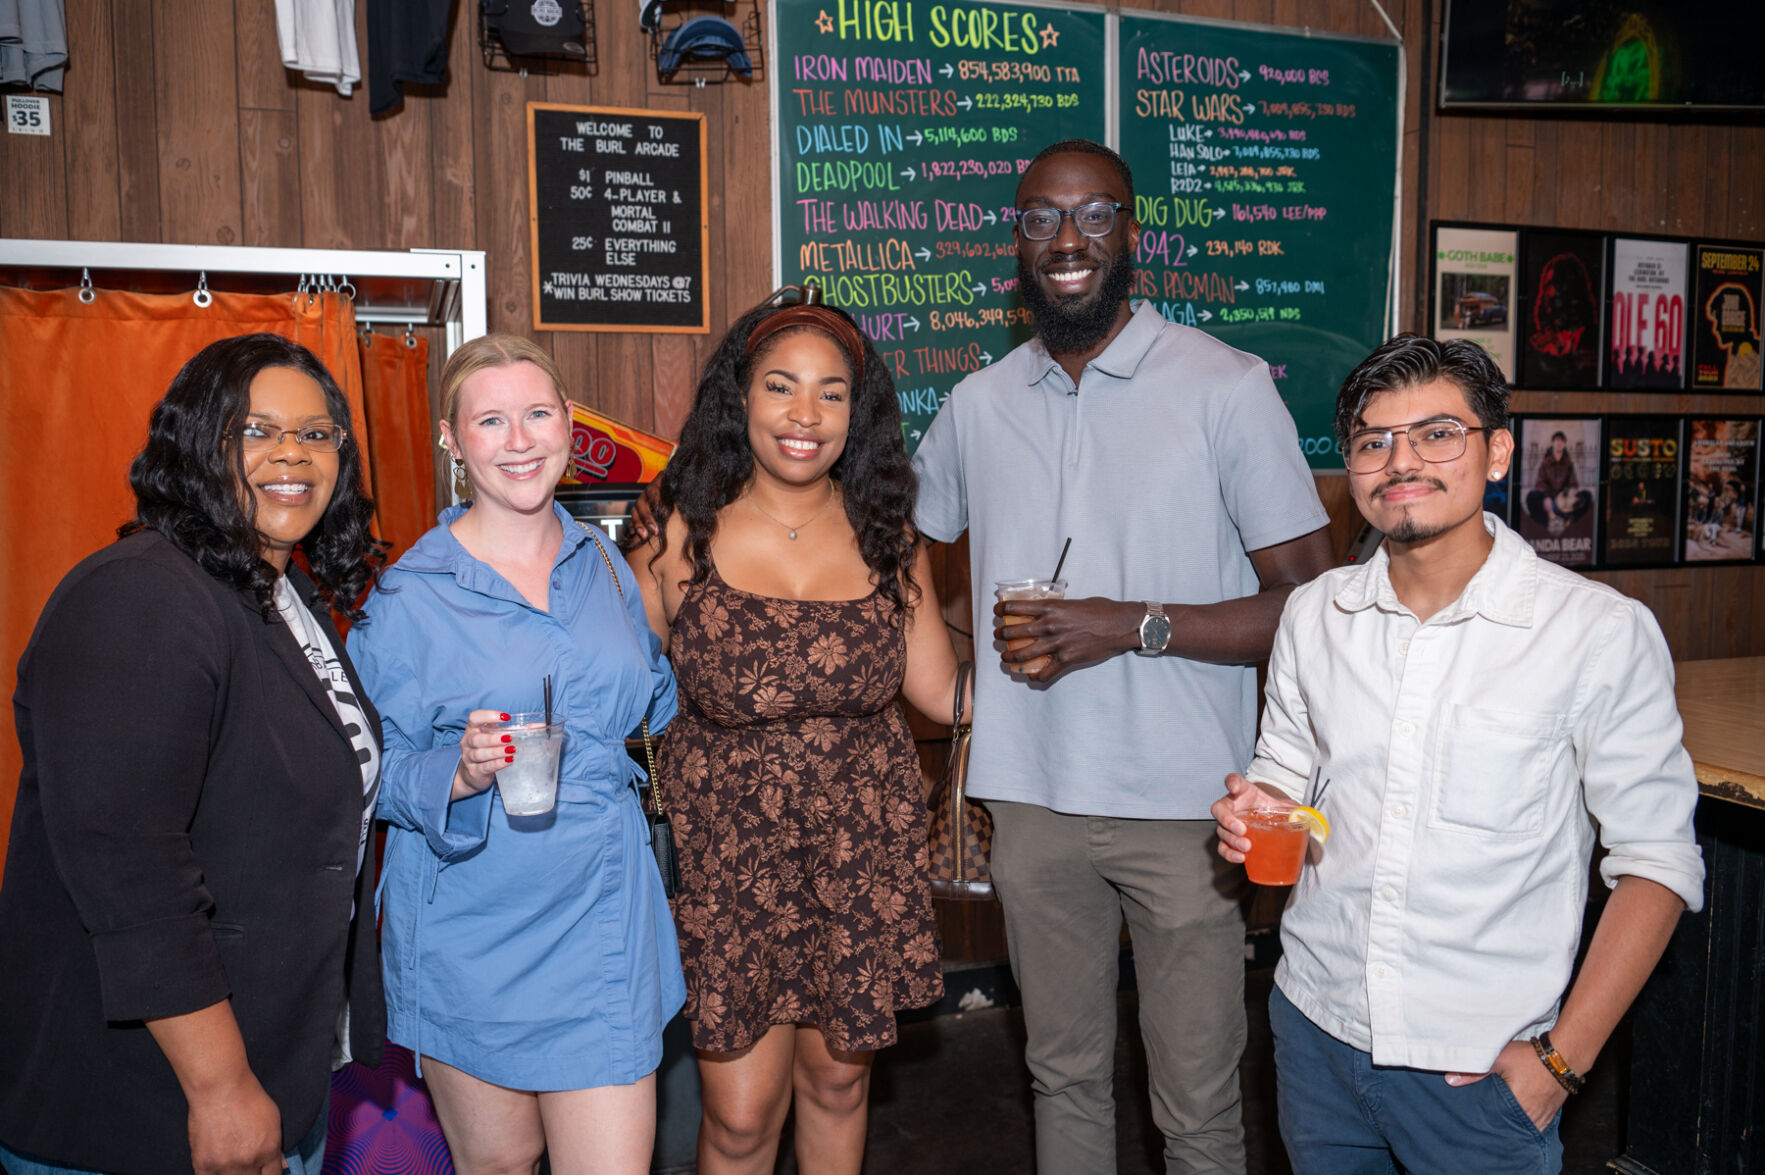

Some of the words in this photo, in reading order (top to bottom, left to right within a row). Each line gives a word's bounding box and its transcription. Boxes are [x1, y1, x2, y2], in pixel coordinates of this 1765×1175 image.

[838, 0, 914, 42] HIGH
[929, 6, 1039, 54] SCORES
[795, 54, 847, 82] IRON
[855, 56, 933, 85] MAIDEN
[958, 60, 1051, 84] 854,583,900
[1055, 66, 1080, 83] TTA
[1137, 46, 1240, 90] ASTEROIDS
[792, 89, 837, 117] THE
[845, 89, 958, 117] MUNSTERS
[976, 93, 1053, 113] 222,324,730
[1057, 93, 1079, 107] BDS
[1135, 89, 1185, 122] STAR
[1192, 93, 1244, 125] WARS
[576, 121, 633, 138] WELCOME
[648, 125, 664, 139] TO
[796, 124, 869, 155] DIALED
[879, 124, 904, 154] IN
[924, 126, 987, 148] 5,114,600
[992, 126, 1018, 143] BDS
[1169, 123, 1205, 142] LUKE
[560, 137, 585, 152] THE
[596, 139, 627, 154] BURL
[635, 143, 680, 157] ARCADE
[1170, 143, 1195, 160] HAN
[1196, 144, 1223, 161] SOLO
[796, 160, 901, 193] DEADPOOL
[922, 159, 1012, 182] 1,822,230,020
[1171, 160, 1196, 176] LEIA
[579, 169, 591, 183] $1
[605, 170, 654, 187] PINBALL
[1171, 177, 1202, 194] R2D2
[604, 186, 667, 204] 4-PLAYER
[672, 190, 682, 205] &
[611, 205, 656, 220] MORTAL
[796, 199, 838, 235] THE
[843, 200, 928, 233] WALKING
[935, 199, 983, 232] DEAD
[1136, 195, 1168, 226] DIG
[1174, 198, 1212, 228] DUG
[1232, 203, 1277, 223] 161,540
[612, 219, 658, 234] COMBAT
[663, 221, 671, 234] II
[605, 237, 677, 254] EVERYTHING
[800, 238, 916, 272] METALLICA
[1136, 230, 1188, 266] 1942
[1206, 240, 1253, 258] 239,140
[1258, 240, 1285, 256] RDK
[605, 253, 637, 266] ELSE
[1447, 249, 1478, 262] GOTH
[1701, 252, 1747, 271] SEPTEMBER
[1748, 255, 1761, 271] 24
[551, 272, 591, 287] TRIVIA
[595, 273, 670, 289] WEDNESDAYS
[1163, 270, 1235, 304] PACMAN
[578, 287, 608, 301] BURL
[610, 288, 643, 302] SHOW
[645, 288, 692, 304] TICKETS
[912, 342, 980, 375] THINGS
[897, 386, 940, 415] NKA
[1609, 438, 1677, 457] SUSTO
[1529, 538, 1560, 552] ANDA
[1561, 537, 1592, 551] BEAR
